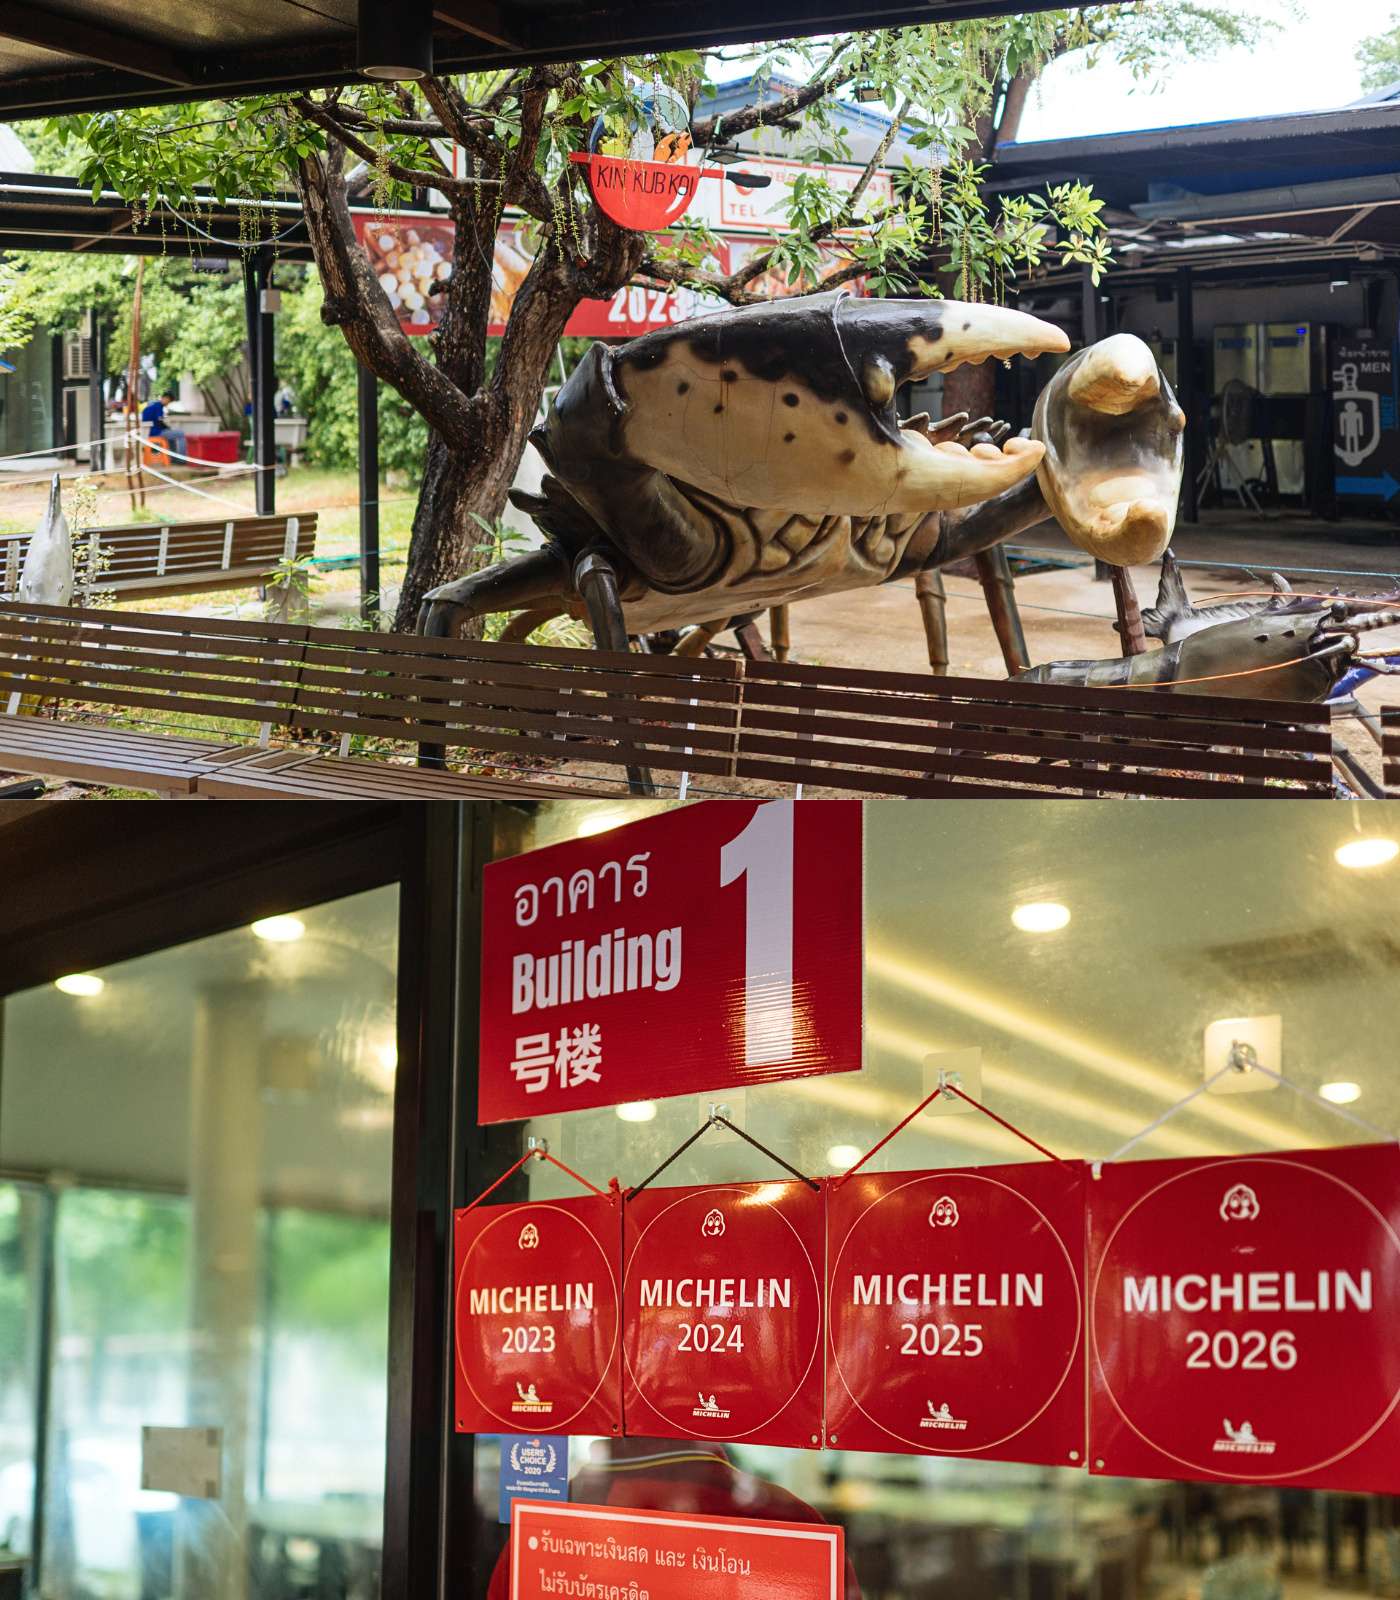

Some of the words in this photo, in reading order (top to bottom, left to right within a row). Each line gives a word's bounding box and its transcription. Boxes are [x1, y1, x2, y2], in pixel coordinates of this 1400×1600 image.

[597, 165, 626, 189] KIN
[633, 170, 666, 194] KUB
[669, 174, 694, 196] KOI
[1360, 362, 1391, 373] MEN
[514, 851, 651, 927] อาคาร
[720, 800, 794, 1066] 1
[512, 926, 682, 1015] Building
[510, 1023, 602, 1093] 号楼
[470, 1282, 594, 1315] MICHELIN
[640, 1278, 791, 1308] MICHELIN
[852, 1273, 1044, 1307] MICHELIN
[1122, 1269, 1372, 1313] MICHELIN
[501, 1326, 556, 1353] 2023
[677, 1323, 744, 1353] 2024
[900, 1323, 983, 1357] 2025
[1185, 1330, 1298, 1370] 2026
[692, 1410, 730, 1419] MICHELIN
[919, 1420, 967, 1430] MICHELIN
[520, 1456, 547, 1465] CHOICE
[524, 1467, 542, 1475] 2020
[541, 1529, 649, 1564] รับเฉพาะเงินสด
[655, 1549, 686, 1567] และ
[692, 1547, 751, 1576] เงินโอน
